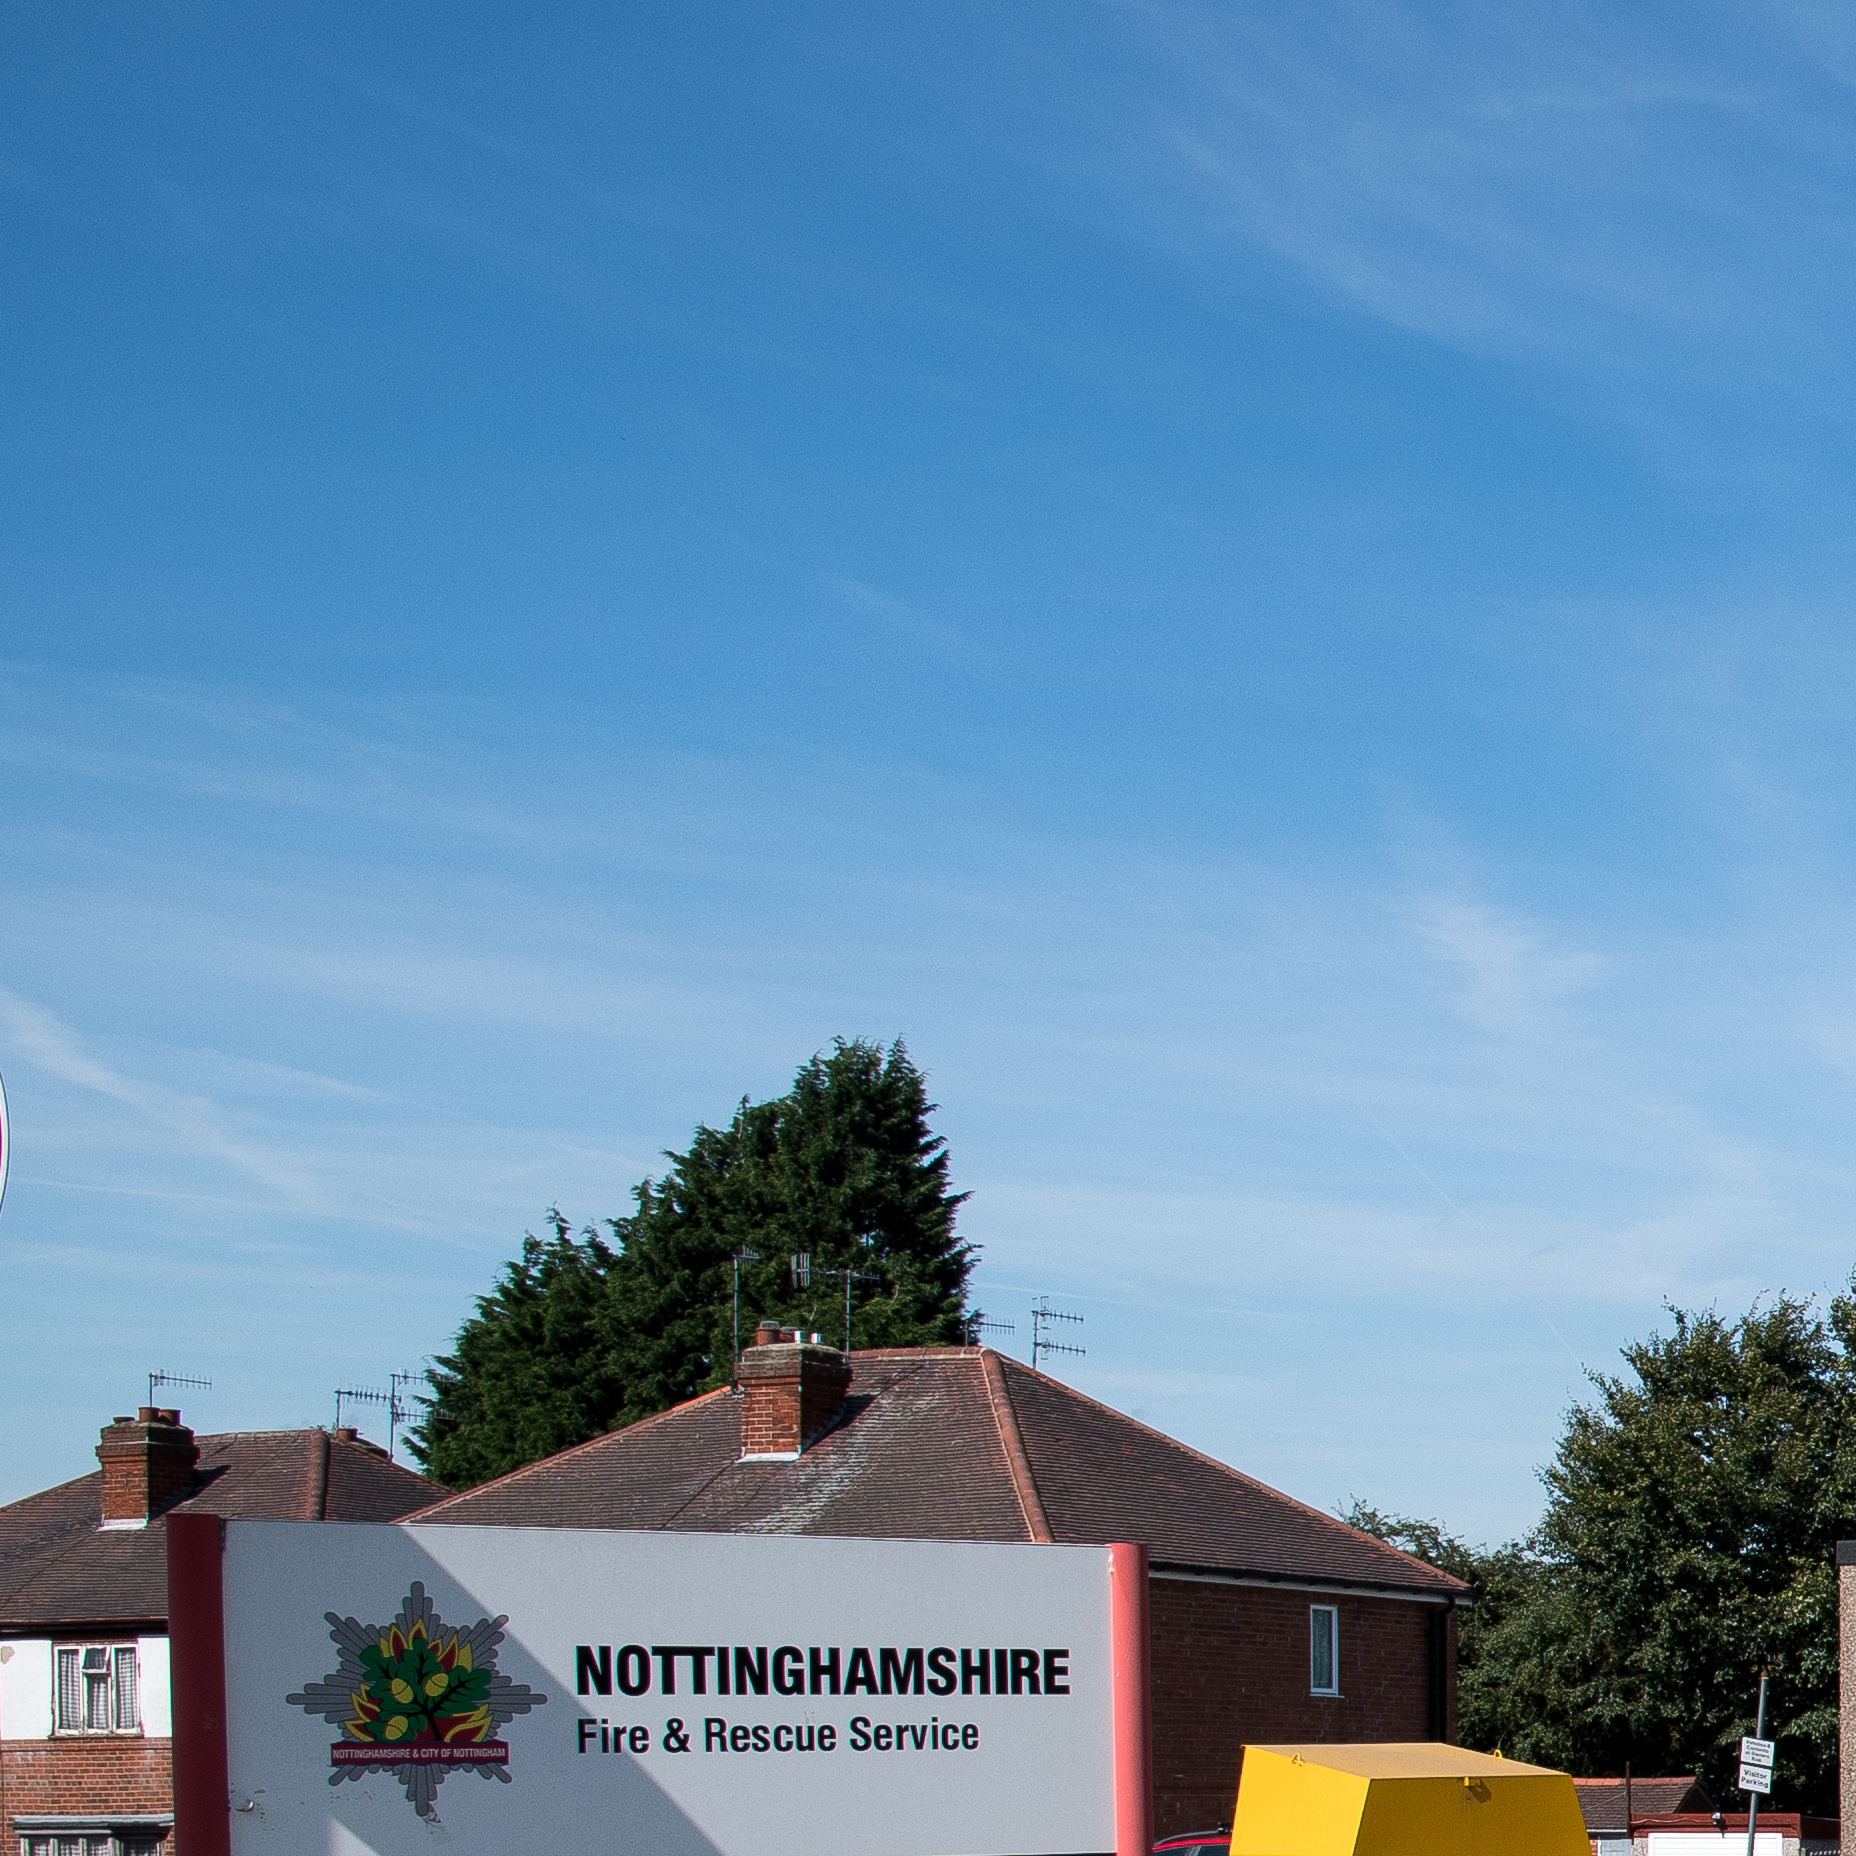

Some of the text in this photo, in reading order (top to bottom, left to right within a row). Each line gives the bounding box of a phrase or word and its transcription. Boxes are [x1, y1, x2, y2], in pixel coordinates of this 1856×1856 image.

[575, 1644, 1071, 1696] NOTTINGHAMSHIRE
[576, 1715, 980, 1753] Fire & Rescue Service
[333, 1748, 506, 1759] NOTTINGHAMSHIRE & CITY OF NOTTINGHAM
